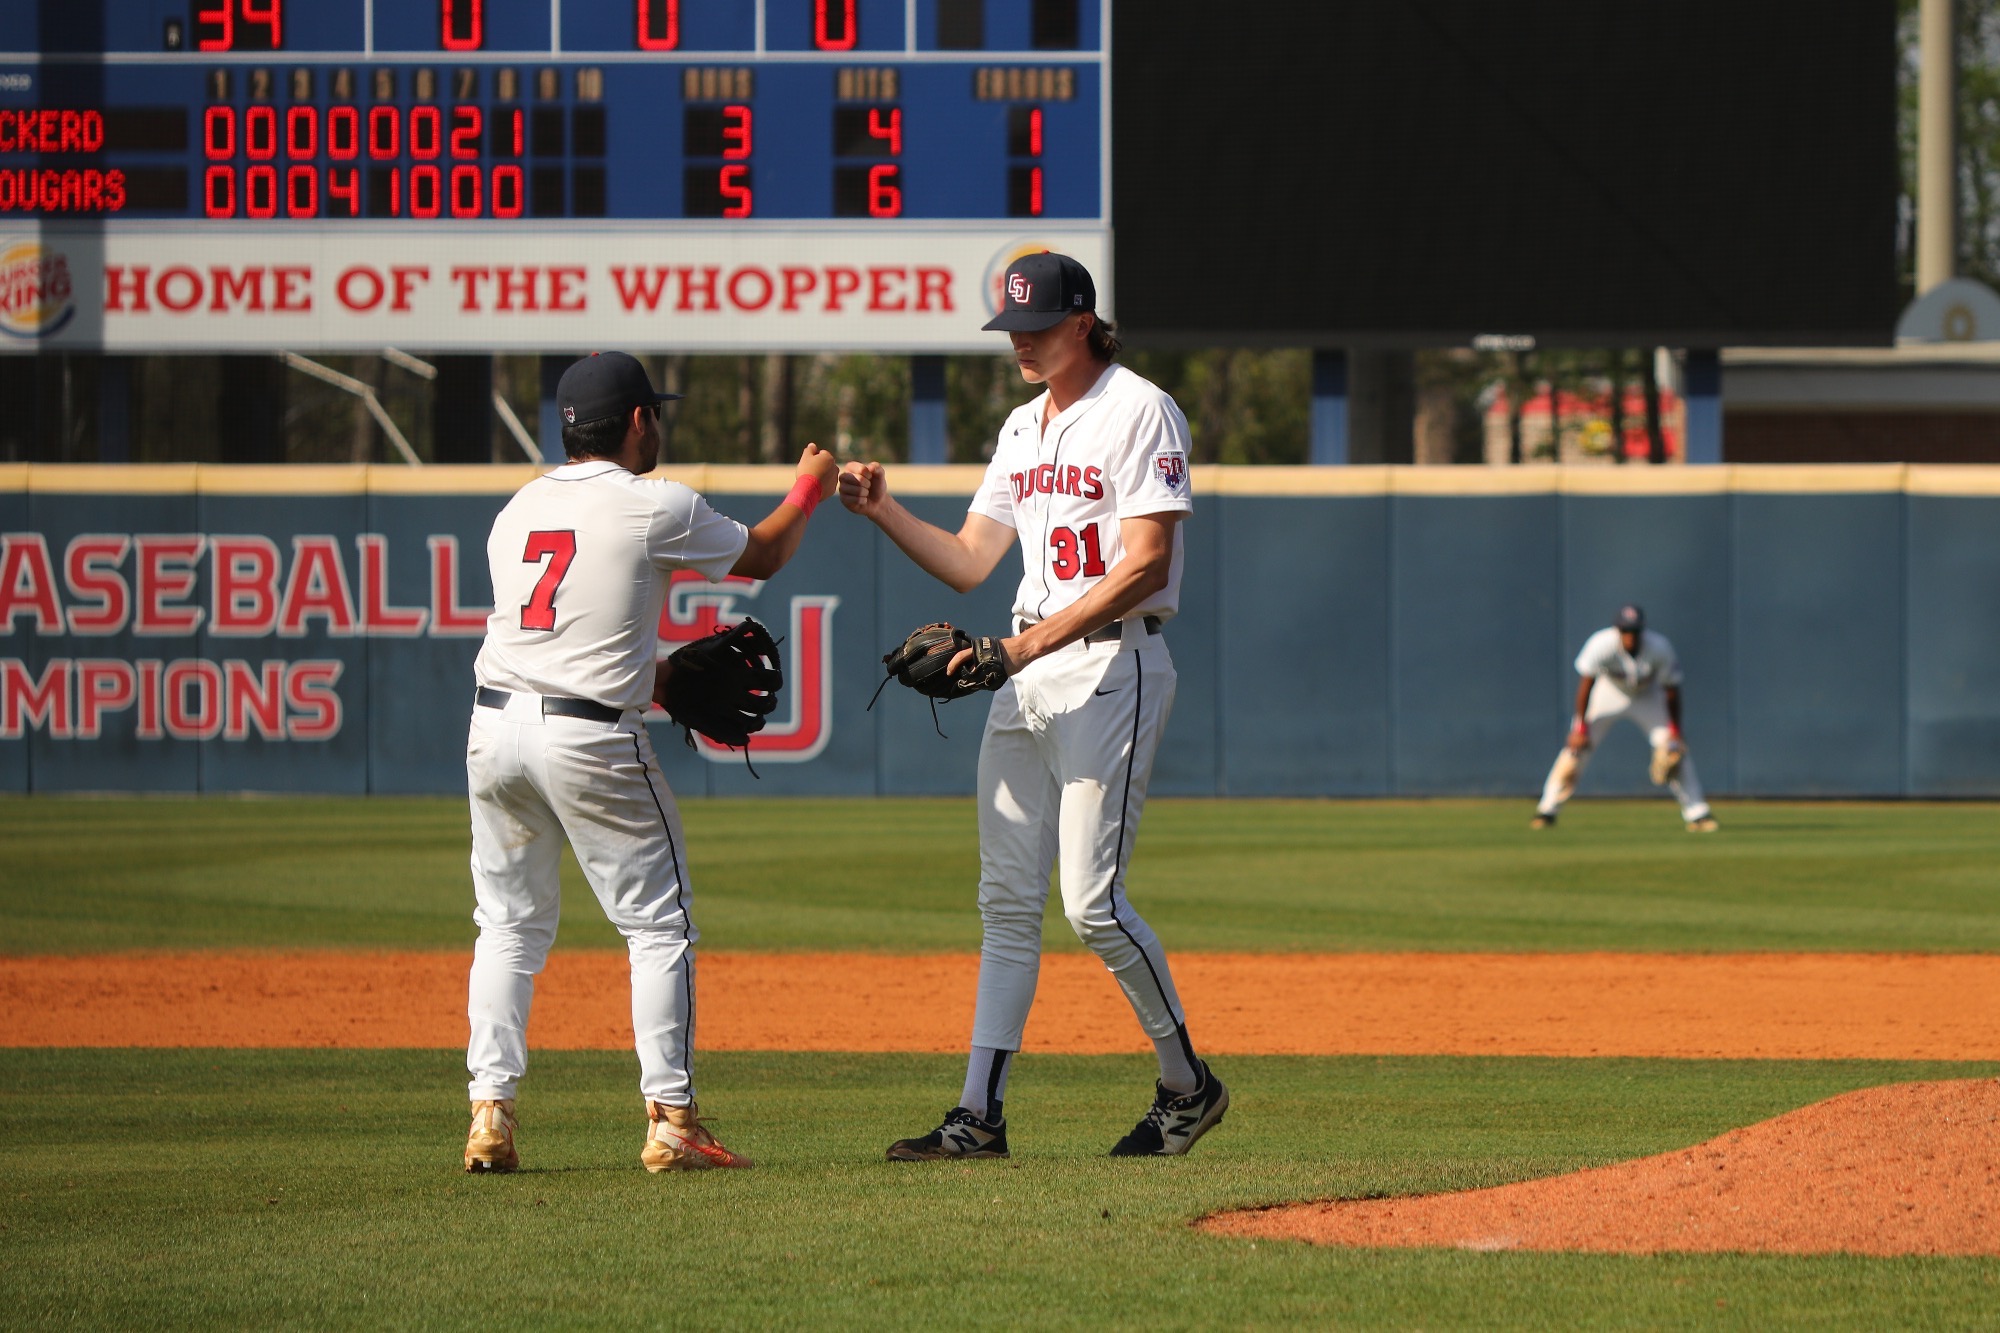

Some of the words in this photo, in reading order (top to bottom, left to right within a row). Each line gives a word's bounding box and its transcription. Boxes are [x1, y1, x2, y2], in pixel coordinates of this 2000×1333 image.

[198, 0, 281, 53] 34
[442, 0, 482, 52] 0
[637, 0, 679, 52] 0
[815, 0, 857, 52] 0
[722, 105, 753, 161] 3
[868, 108, 902, 156] 4
[1030, 108, 1043, 157] 1
[0, 169, 126, 212] OUGARS
[719, 164, 753, 219] 5
[868, 164, 902, 219] 6
[1030, 167, 1043, 216] 1
[104, 265, 313, 313] HOME
[335, 265, 431, 313] OF
[450, 265, 588, 313] THE
[609, 265, 956, 313] WHOPPER
[1009, 462, 1104, 504] OUGARS
[1049, 522, 1106, 581] 31
[0, 532, 490, 637] ASEBALL
[520, 530, 576, 632] 7
[0, 658, 344, 742] MPIONS
